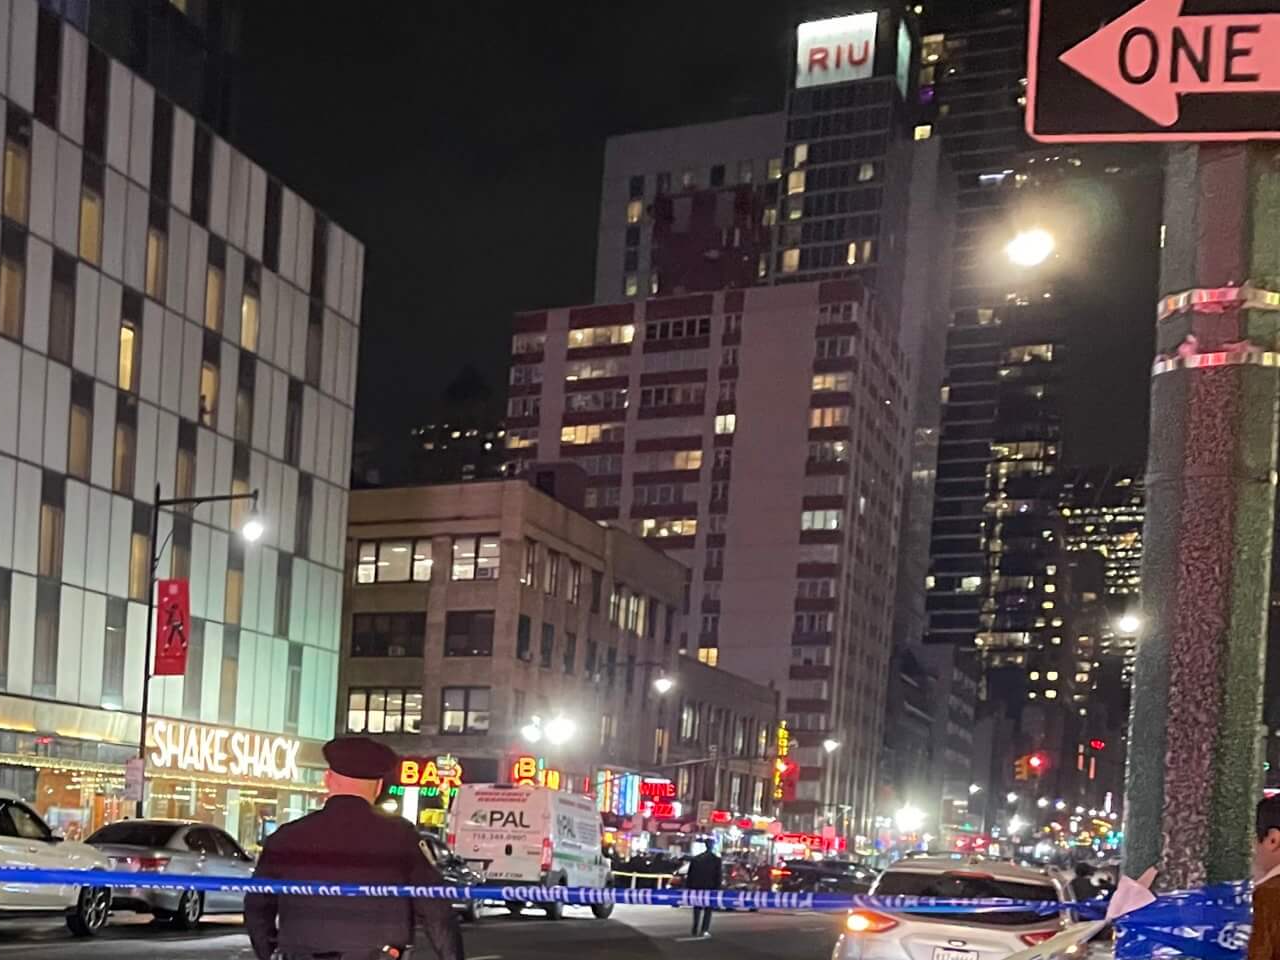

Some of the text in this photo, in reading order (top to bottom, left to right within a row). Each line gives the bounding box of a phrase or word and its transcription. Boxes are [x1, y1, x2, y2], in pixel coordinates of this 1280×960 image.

[808, 40, 871, 74] RIU
[1118, 24, 1261, 85] ONE
[151, 720, 300, 781] SHAKE SHACK
[489, 810, 530, 829] PAL
